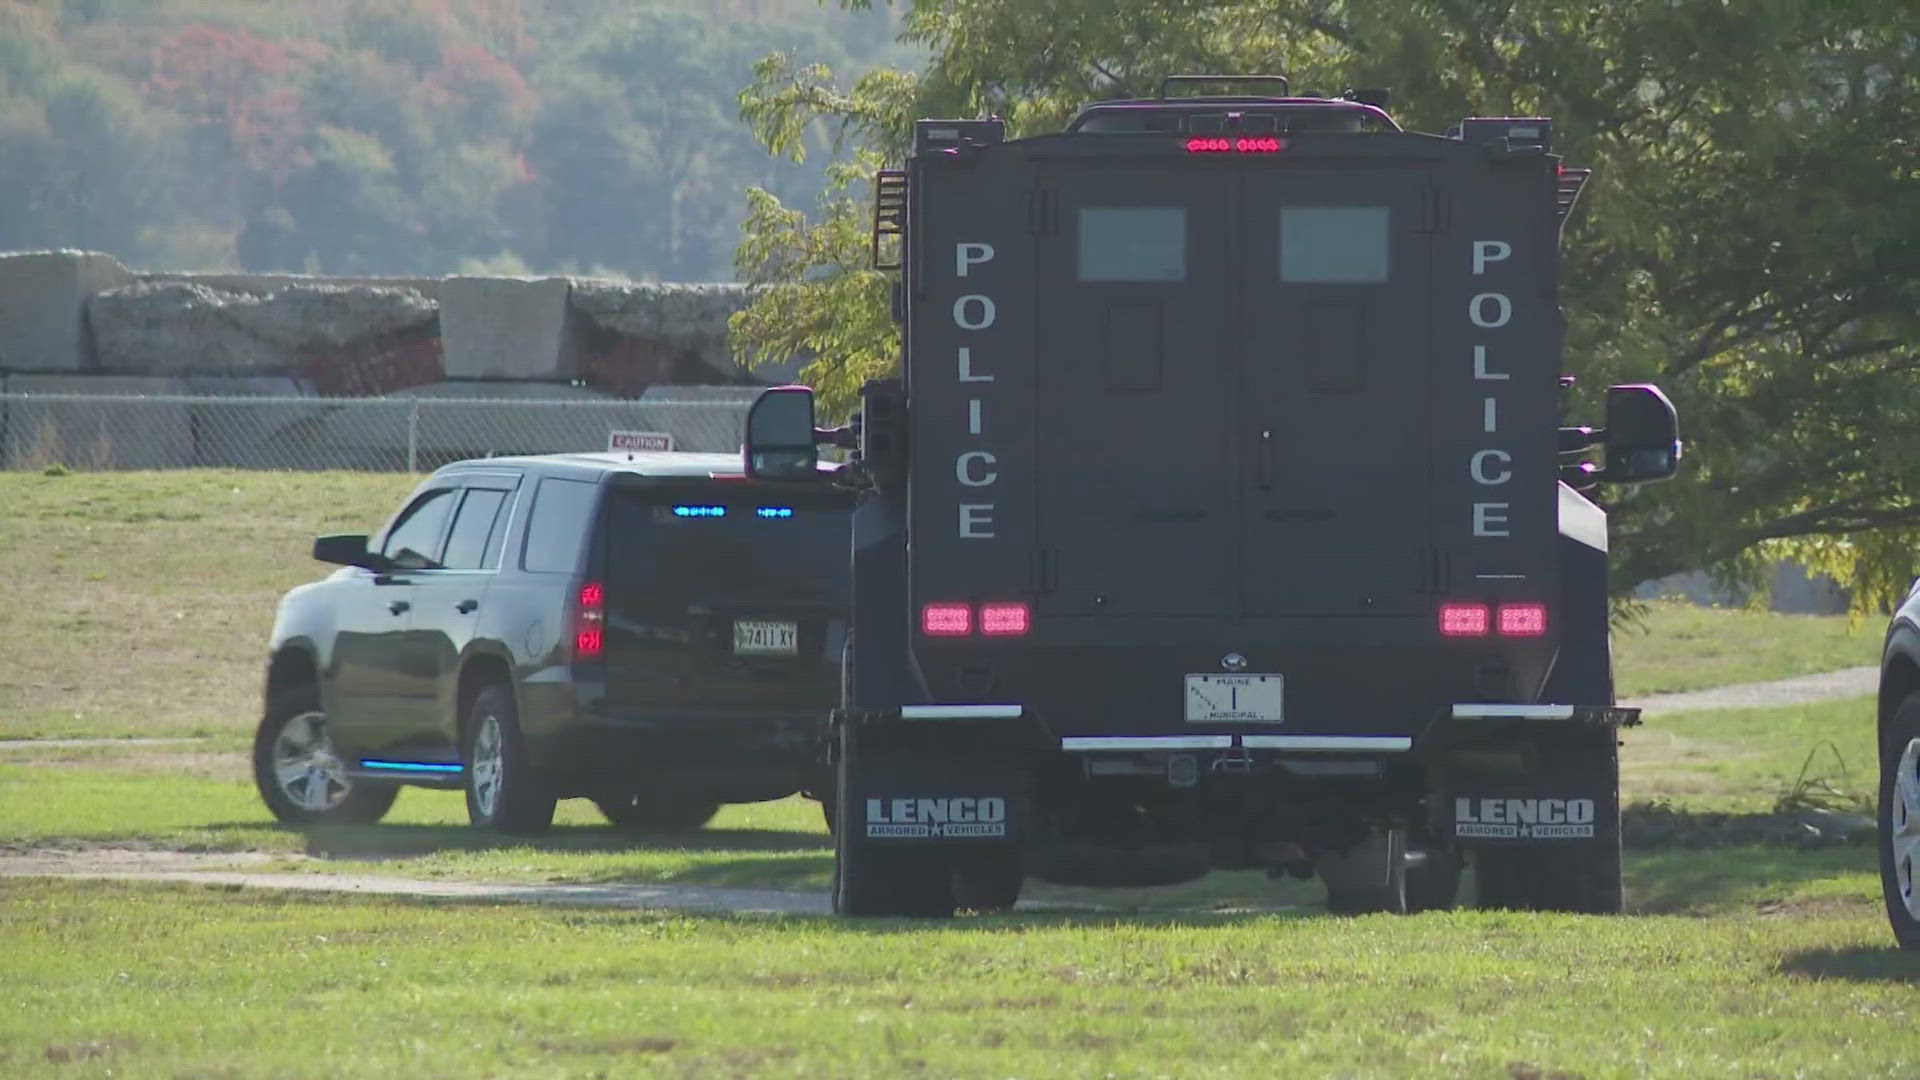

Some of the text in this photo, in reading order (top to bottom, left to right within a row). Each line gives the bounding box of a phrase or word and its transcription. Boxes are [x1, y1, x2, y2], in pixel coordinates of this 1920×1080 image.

[953, 242, 997, 538] POLICE
[1469, 240, 1512, 536] POLICE
[615, 436, 665, 448] CAUTION
[780, 629, 794, 646] XY
[1209, 711, 1258, 719] MUNICIPAL
[867, 798, 1005, 823] LENCO
[1456, 798, 1594, 823] LENCO
[869, 825, 1003, 836] ARMORED VEHICLES
[1459, 825, 1592, 836] ARMORED VEHICLES
